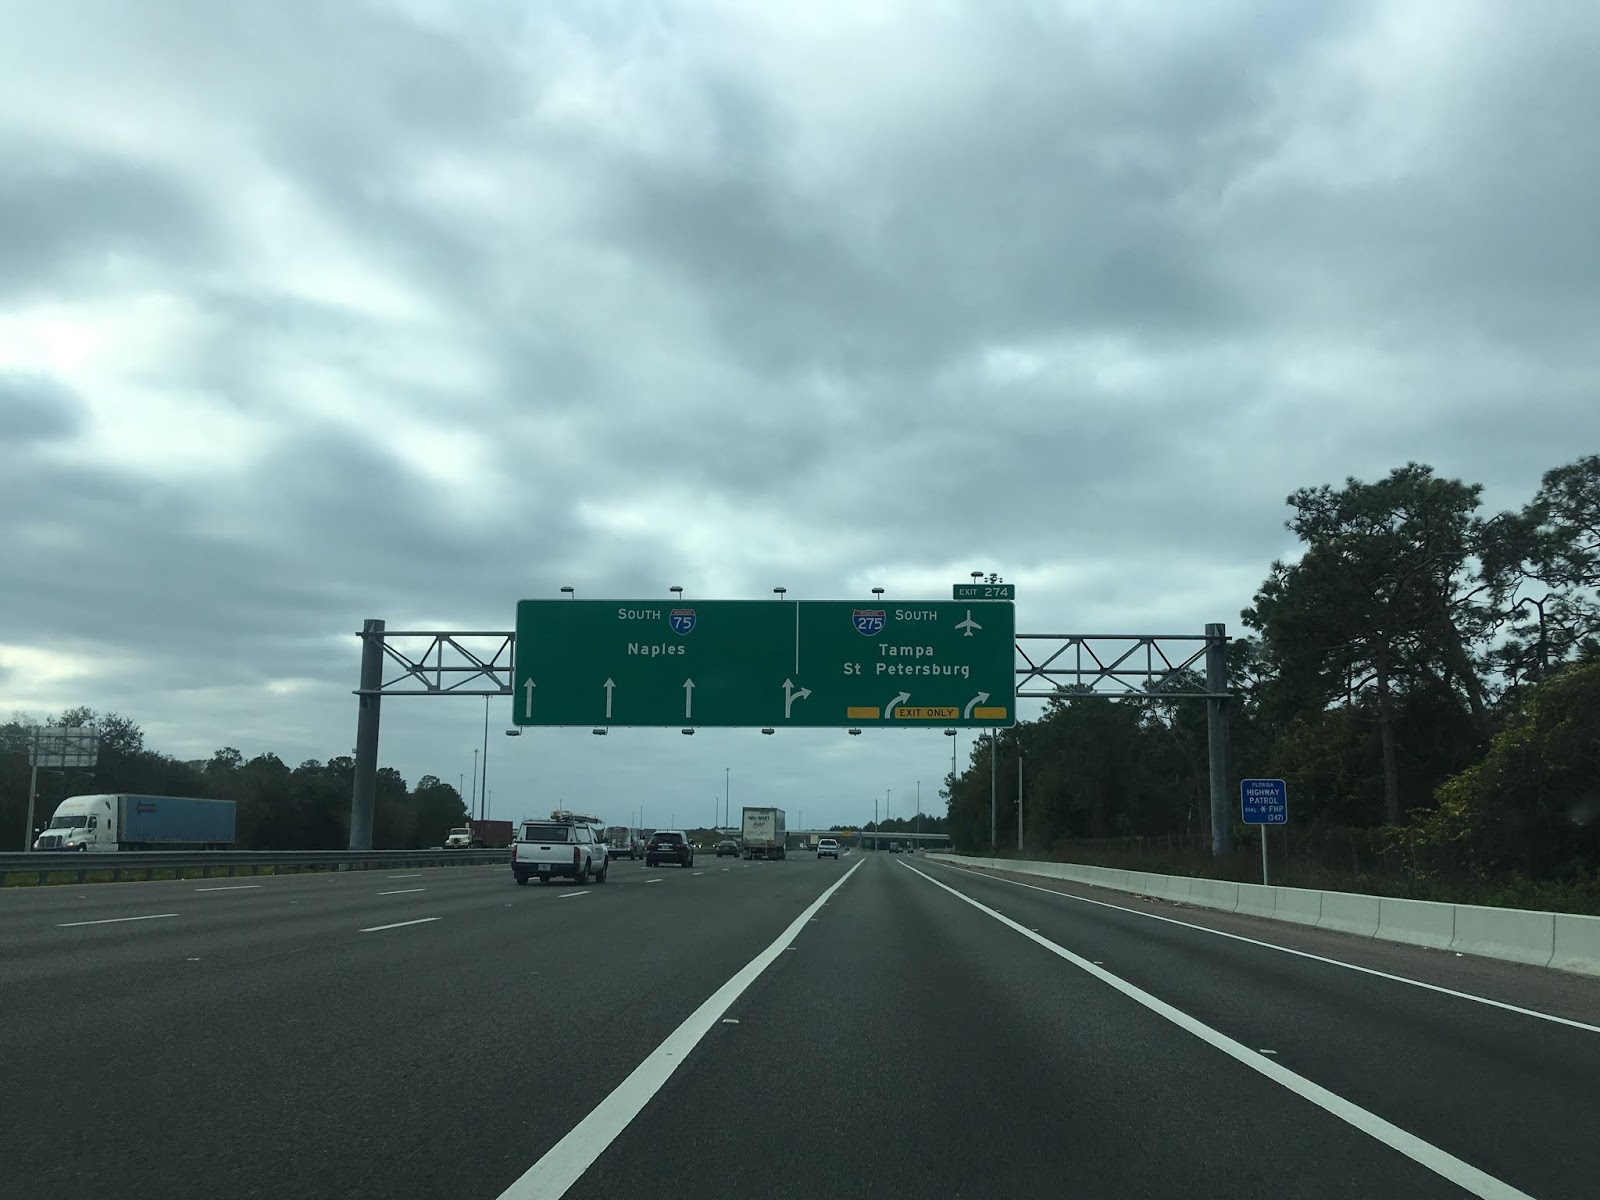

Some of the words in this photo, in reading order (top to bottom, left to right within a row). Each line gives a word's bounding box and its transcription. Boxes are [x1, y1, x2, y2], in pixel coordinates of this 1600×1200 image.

[959, 588, 978, 596] EXIT
[984, 587, 1009, 597] 274
[618, 608, 661, 620] SOUTH
[673, 616, 692, 629] 75
[858, 617, 883, 630] 275
[895, 609, 937, 621] SOUTH
[627, 643, 686, 657] Naples
[879, 643, 934, 658] Tampa
[843, 662, 861, 675] St
[876, 662, 970, 679] Petersburg
[899, 707, 921, 717] EXIT
[927, 707, 954, 717] ONLY
